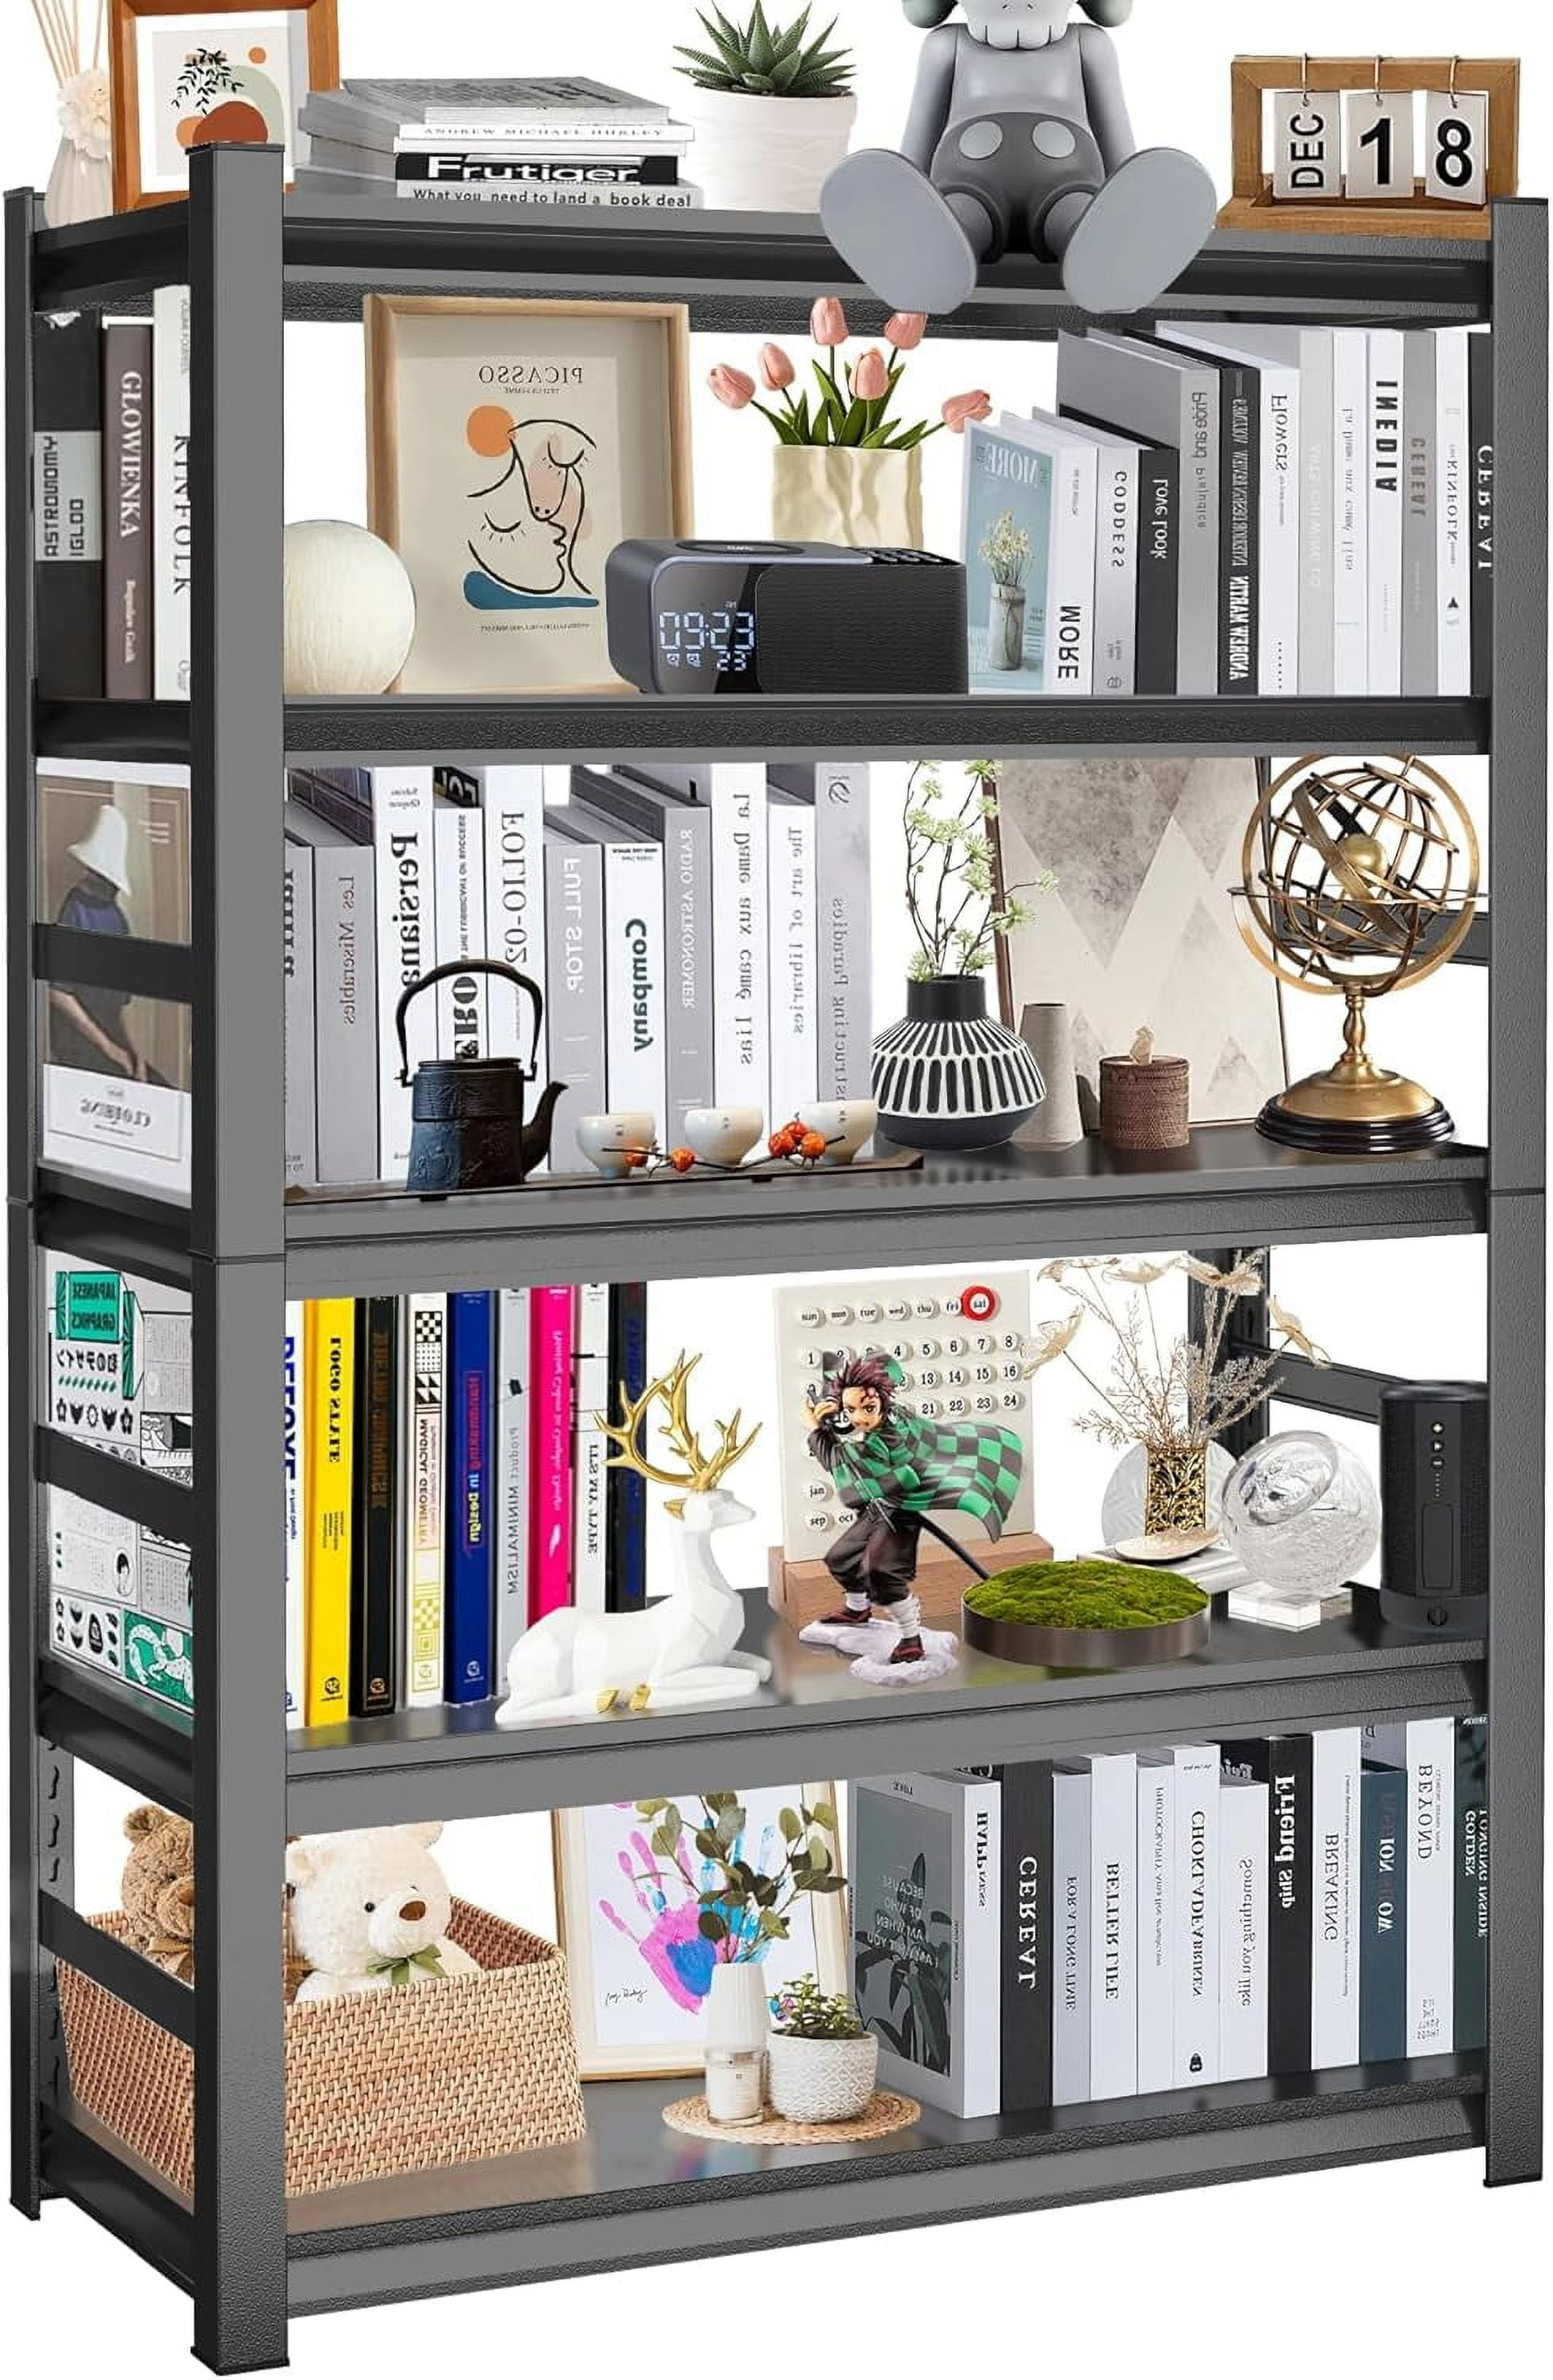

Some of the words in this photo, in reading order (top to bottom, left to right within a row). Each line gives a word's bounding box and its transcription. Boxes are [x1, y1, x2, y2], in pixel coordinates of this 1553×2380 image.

[1290, 113, 1324, 188] DEC
[1360, 117, 1391, 185] 1
[1436, 118, 1473, 187] 8
[427, 155, 640, 182] Frutiger
[413, 189, 450, 202] What
[490, 191, 528, 203] need
[533, 192, 547, 203] to
[554, 191, 587, 205] land
[592, 195, 601, 205] a
[610, 191, 651, 206] book
[656, 192, 691, 207] deal
[120, 370, 143, 538] GLOWIENKA
[44, 436, 59, 557] ASTRONOMY
[173, 434, 191, 596] KINFOLK
[69, 497, 85, 557] IGLOO
[659, 611, 755, 651] 09:23
[976, 1338, 986, 1350] 7
[1005, 1334, 1014, 1349] 8
[893, 1345, 902, 1357] 4
[922, 1343, 931, 1356] 5
[808, 1352, 814, 1365] 1
[949, 1370, 961, 1383] 14
[976, 1368, 989, 1380] 15
[1003, 1365, 1016, 1378] 16
[921, 1372, 935, 1385] 13
[949, 1400, 964, 1412] 22
[977, 1397, 991, 1409] 23
[1003, 1395, 1017, 1407] 24
[922, 1403, 934, 1415] 21
